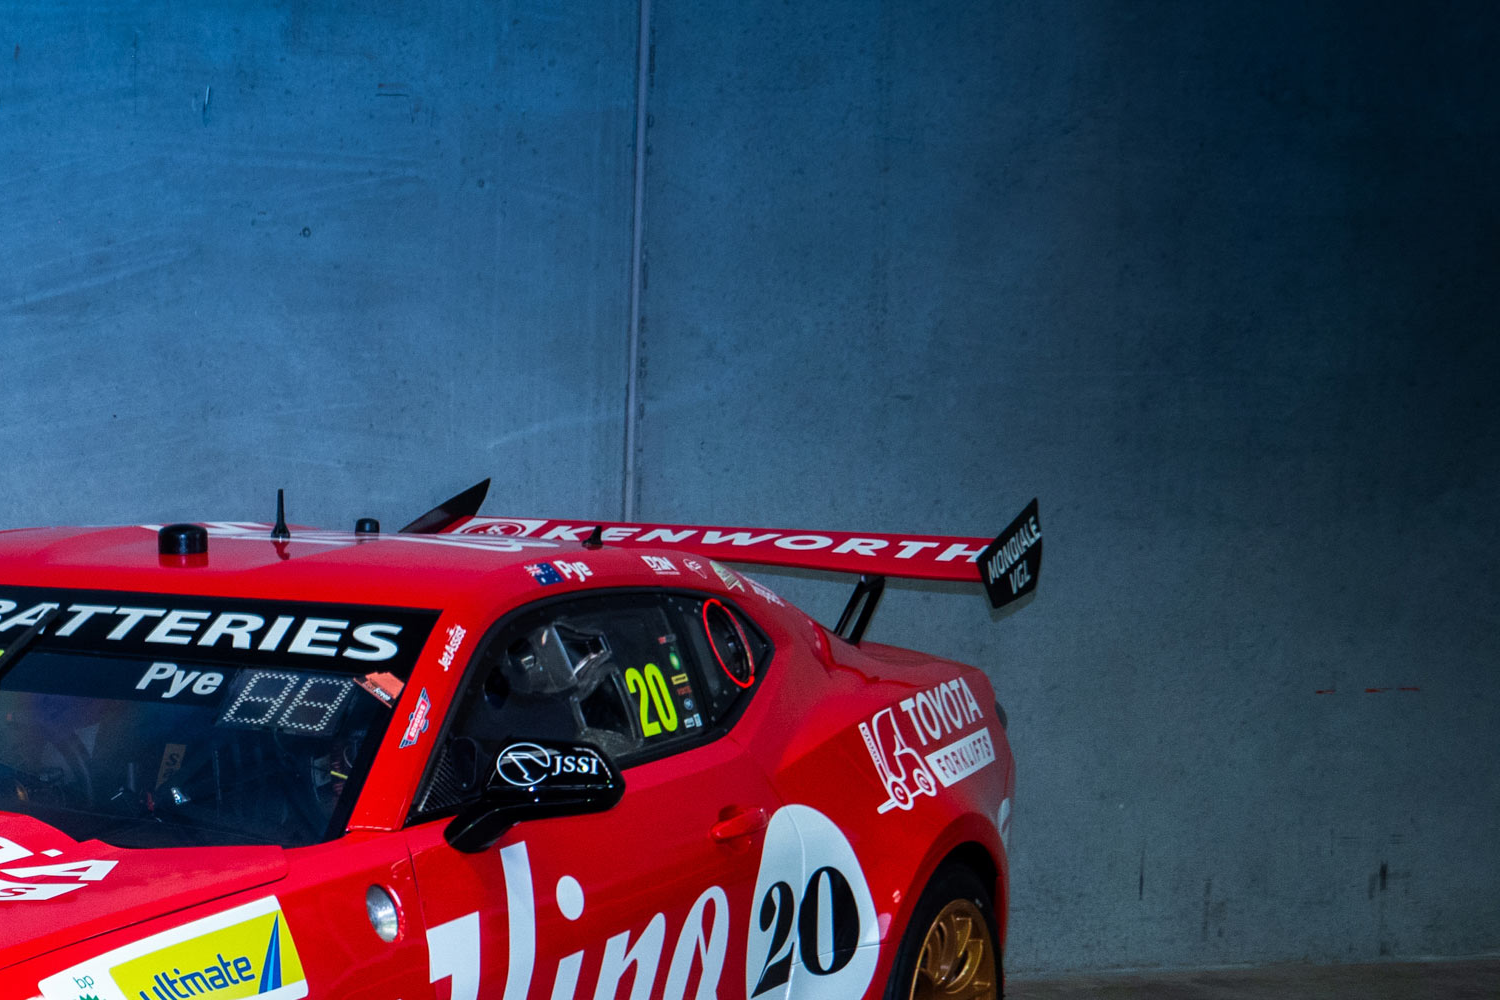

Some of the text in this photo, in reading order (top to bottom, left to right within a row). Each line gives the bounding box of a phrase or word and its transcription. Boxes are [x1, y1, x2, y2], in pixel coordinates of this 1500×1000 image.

[539, 524, 991, 563] KENWORTH
[988, 515, 1041, 585] MONDIALE
[553, 559, 593, 583] Pye
[1009, 559, 1031, 595] VGL
[135, 662, 224, 698] Pye
[625, 662, 678, 738] 20
[899, 676, 984, 746] TOYOTA
[551, 755, 599, 775] JSSI
[935, 734, 992, 780] FORKLIFTS
[750, 865, 861, 999] 20
[73, 973, 95, 991] bp
